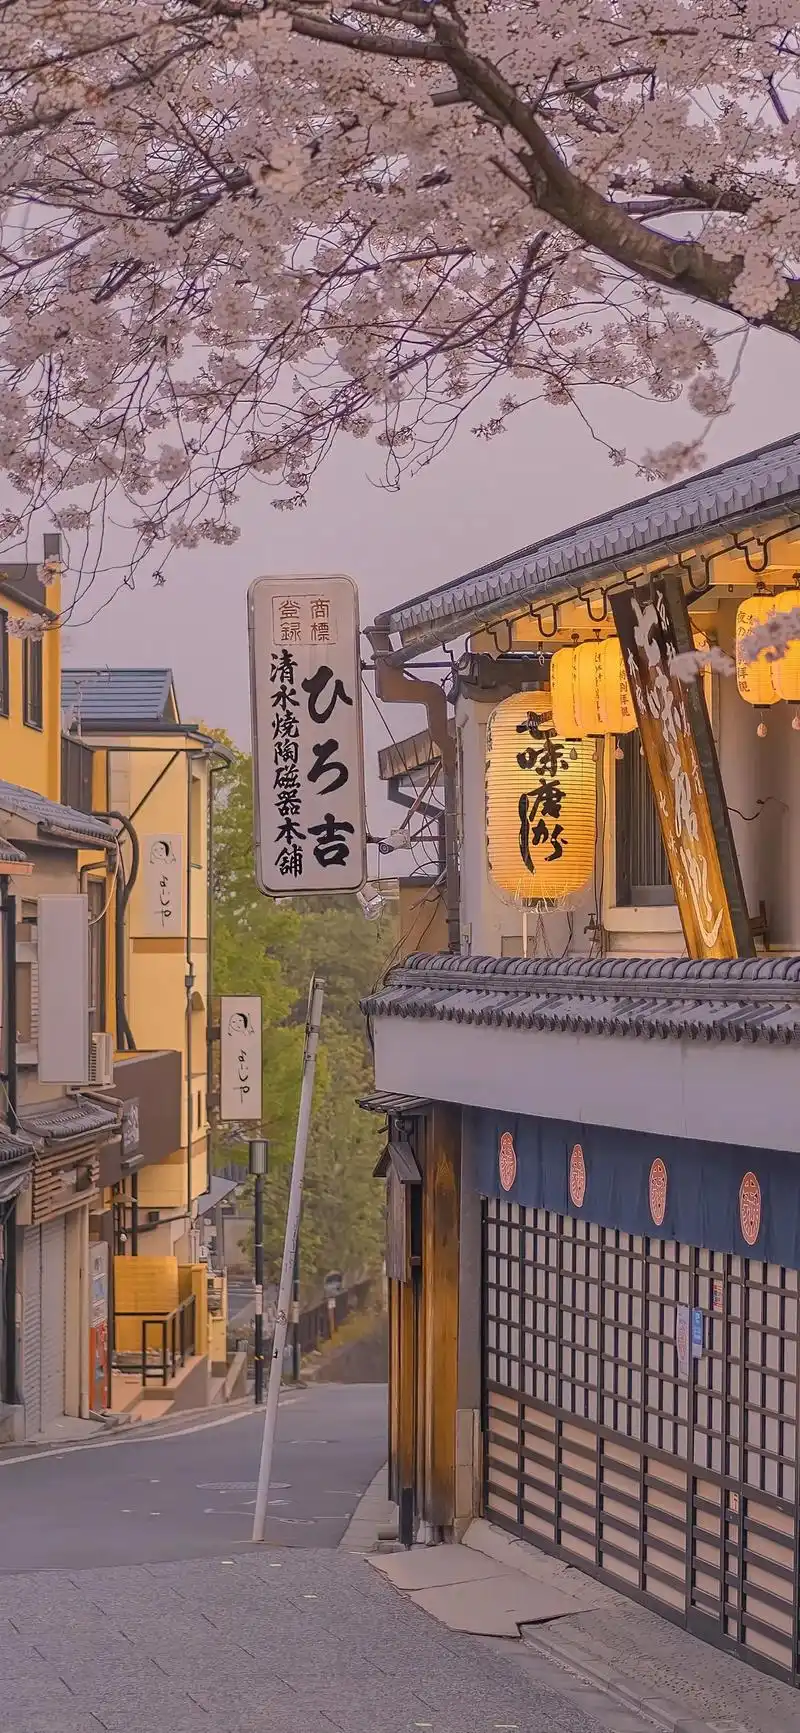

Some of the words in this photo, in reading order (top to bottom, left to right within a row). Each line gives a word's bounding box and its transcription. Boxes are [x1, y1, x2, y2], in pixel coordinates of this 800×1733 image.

[279, 599, 302, 642] 登録
[310, 598, 331, 642] 商標
[269, 648, 307, 878] 清水焼陶磁器本舗
[302, 665, 355, 868] ひろ吉
